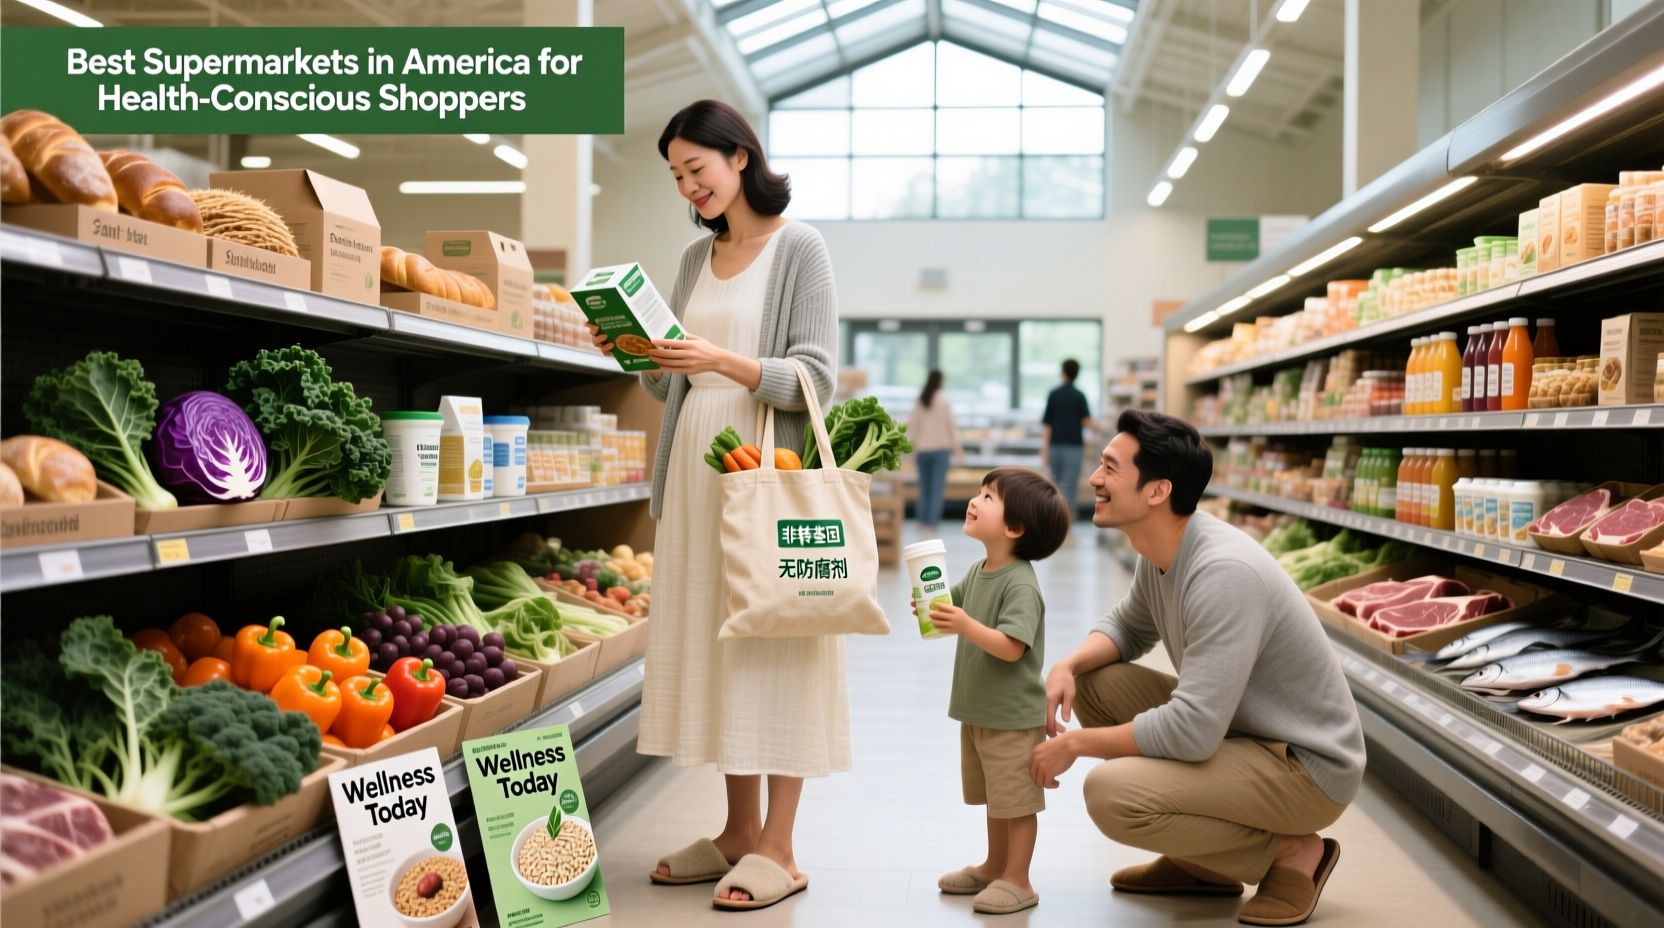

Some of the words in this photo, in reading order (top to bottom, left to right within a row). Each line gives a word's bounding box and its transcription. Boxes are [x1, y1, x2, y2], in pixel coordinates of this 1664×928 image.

[778, 557, 848, 579] 无防腐剂
[475, 746, 566, 777] Wellness
[341, 766, 436, 804] Wellness
[496, 771, 558, 799] Today
[364, 795, 428, 826] Today
